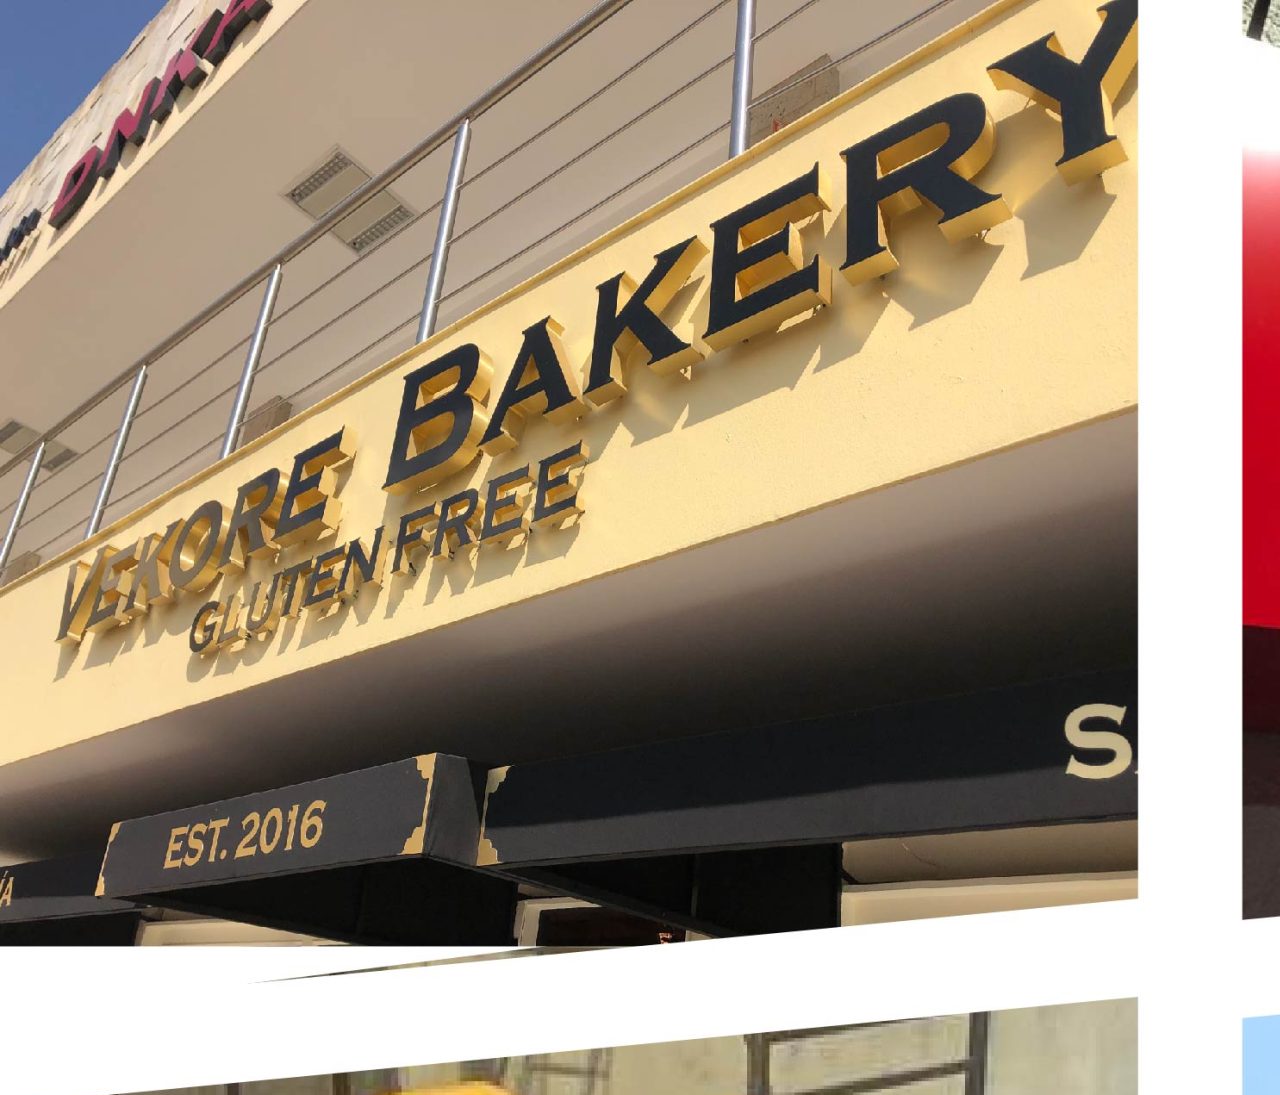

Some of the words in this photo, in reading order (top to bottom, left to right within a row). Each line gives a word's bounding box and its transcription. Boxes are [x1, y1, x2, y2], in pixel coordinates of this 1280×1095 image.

[55, 425, 357, 647] VEKORE
[382, 0, 1138, 494] BAKERY
[188, 525, 388, 656] GLUTEN
[390, 440, 591, 578] FREE
[1064, 703, 1138, 779] S
[163, 817, 230, 869] EST.
[234, 800, 327, 859] 2016
